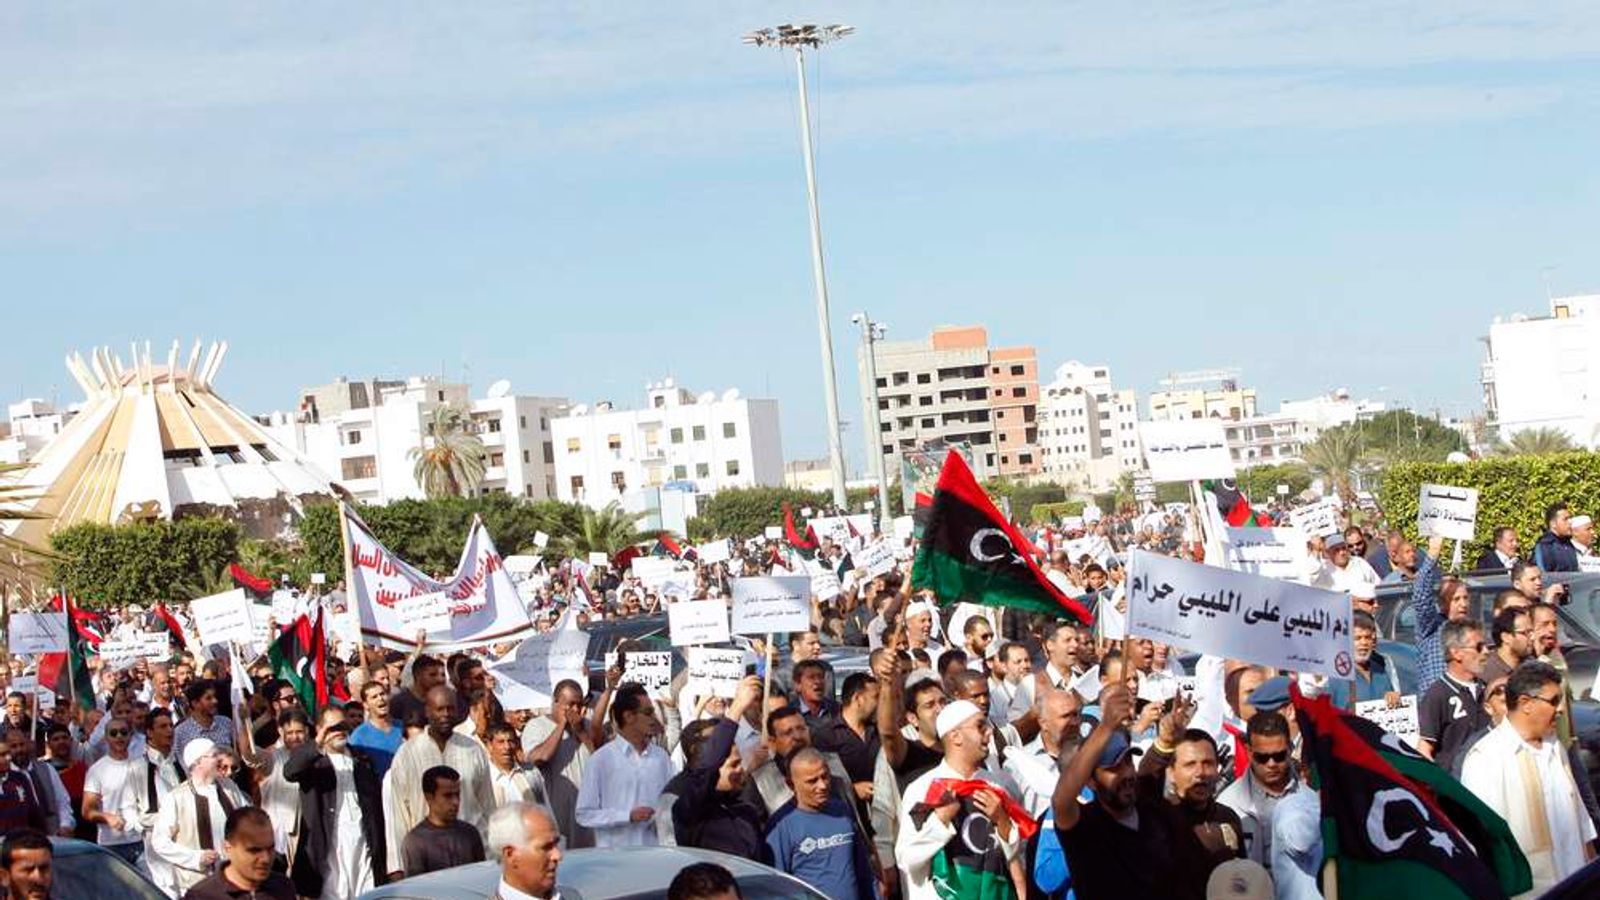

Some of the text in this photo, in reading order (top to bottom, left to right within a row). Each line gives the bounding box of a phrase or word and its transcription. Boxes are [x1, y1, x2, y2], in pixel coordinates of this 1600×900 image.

[1131, 573, 1349, 641] دم الليبي على الليبي حرام
[662, 653, 670, 667] لا
[654, 675, 670, 690] عن
[1449, 696, 1467, 719] 2
